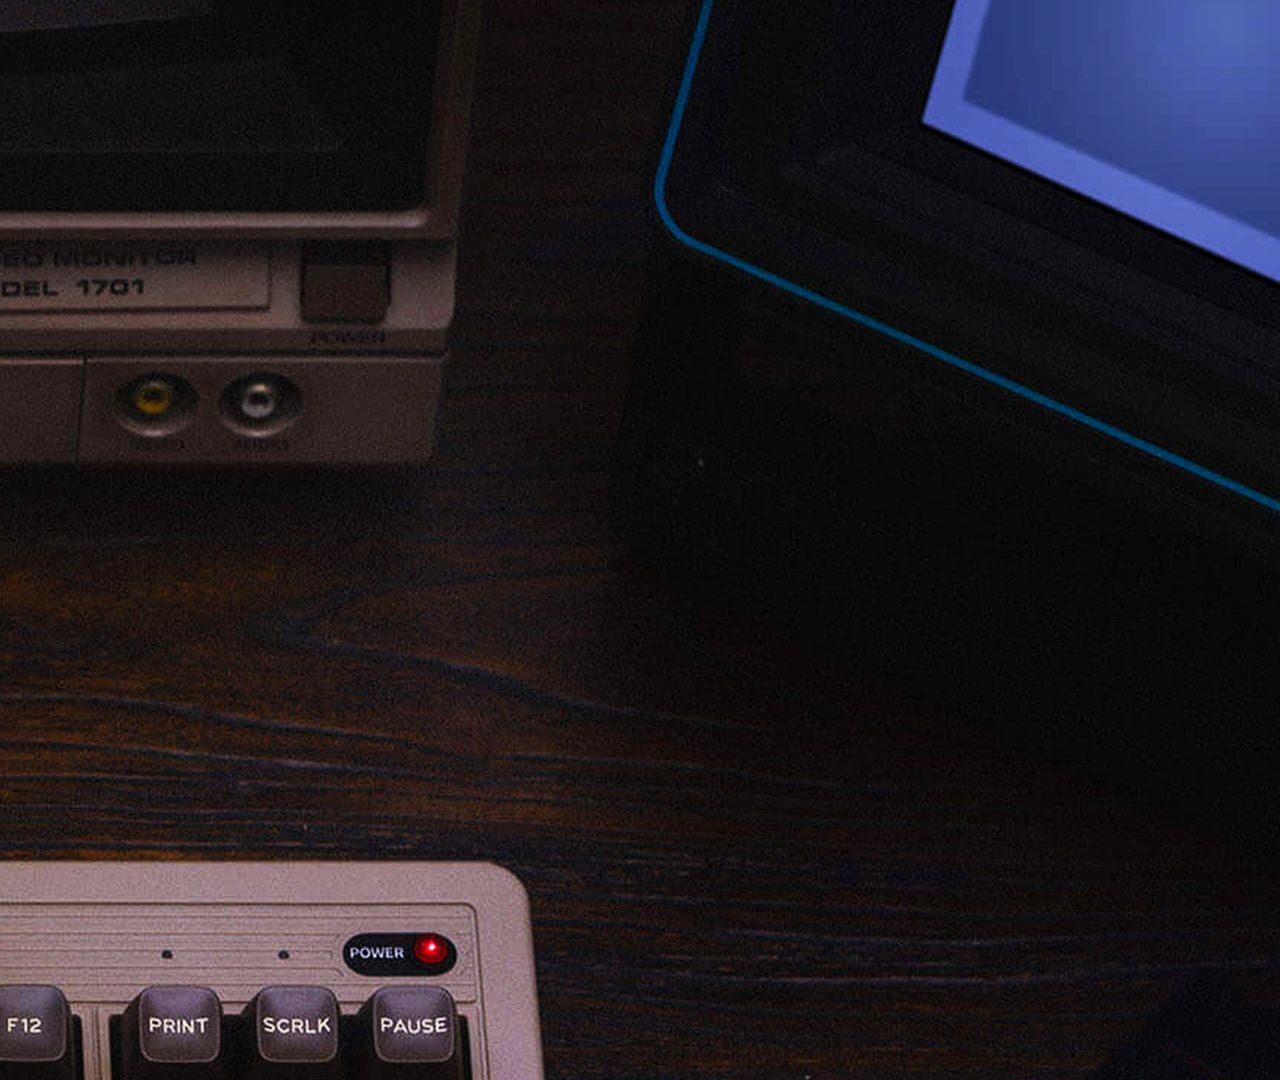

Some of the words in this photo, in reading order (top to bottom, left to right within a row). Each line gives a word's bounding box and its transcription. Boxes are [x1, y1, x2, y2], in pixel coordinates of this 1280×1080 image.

[53, 248, 198, 268] MONITOR
[77, 279, 146, 296] 1701
[349, 946, 405, 959] POWER
[7, 1017, 42, 1034] F12
[149, 1017, 209, 1034] PRINT
[263, 1017, 331, 1034] SCRLK
[380, 1017, 447, 1035] PAUSE
